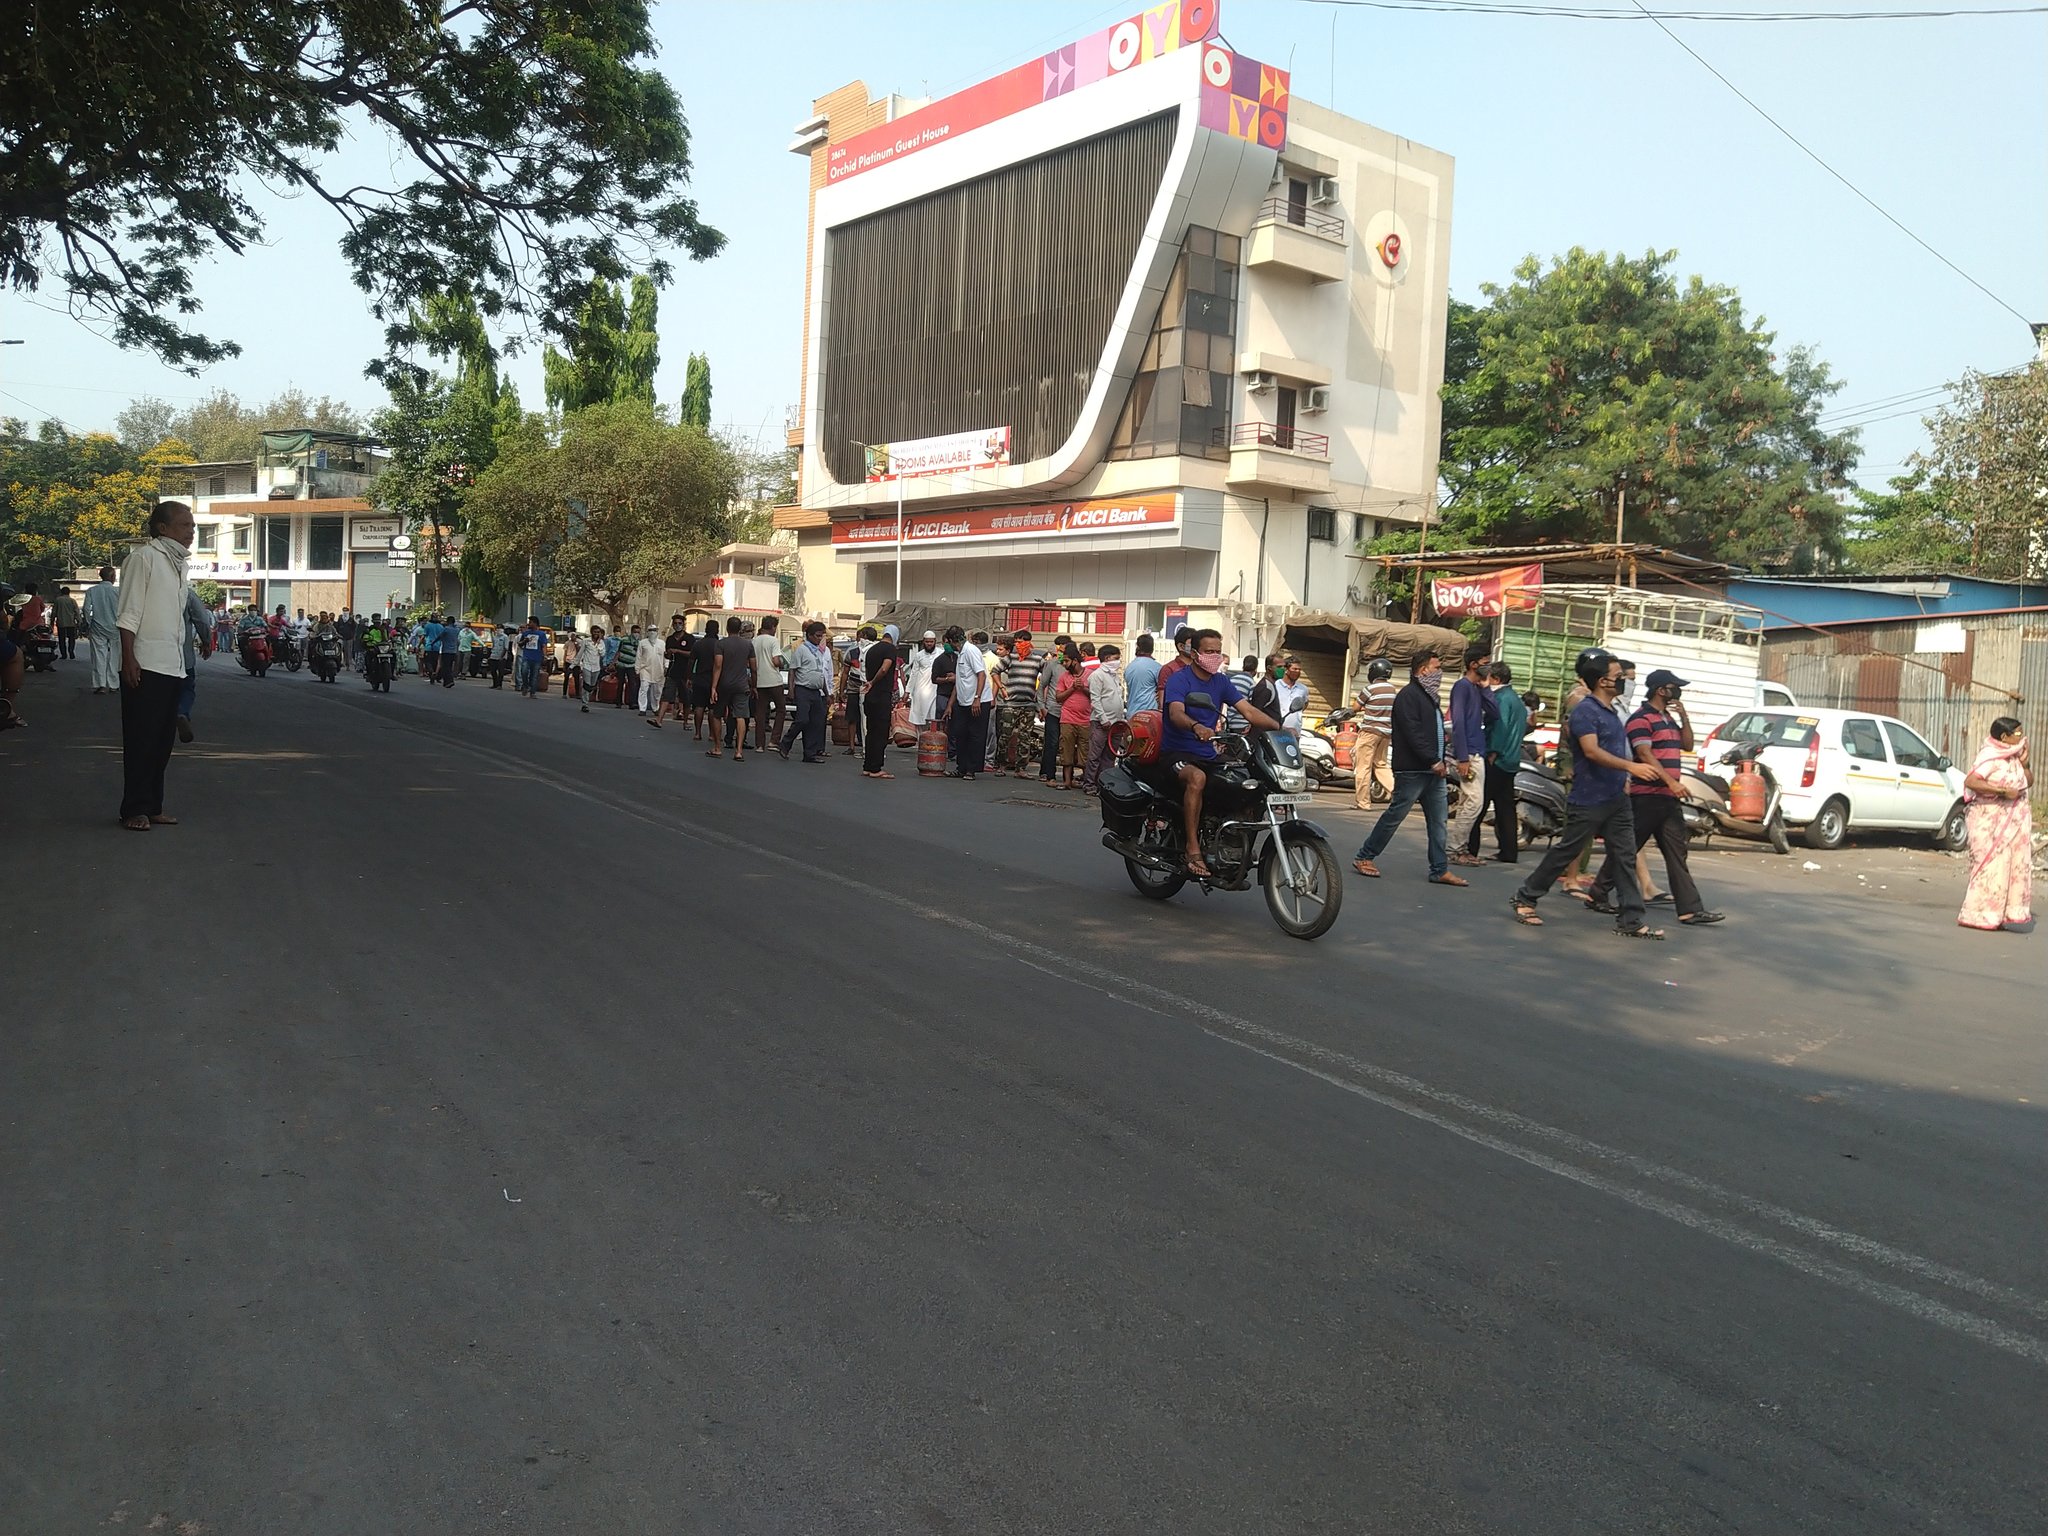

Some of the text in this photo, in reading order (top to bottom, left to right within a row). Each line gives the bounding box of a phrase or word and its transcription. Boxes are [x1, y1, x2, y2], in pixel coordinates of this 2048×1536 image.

[1108, 0, 1216, 71] OYO
[1204, 49, 1231, 87] O
[830, 125, 950, 179] Orchid Platinum Guest House
[928, 450, 972, 465] AVAILABLE
[912, 520, 970, 537] ICICI Bank
[1072, 506, 1148, 526] ICICI Bank
